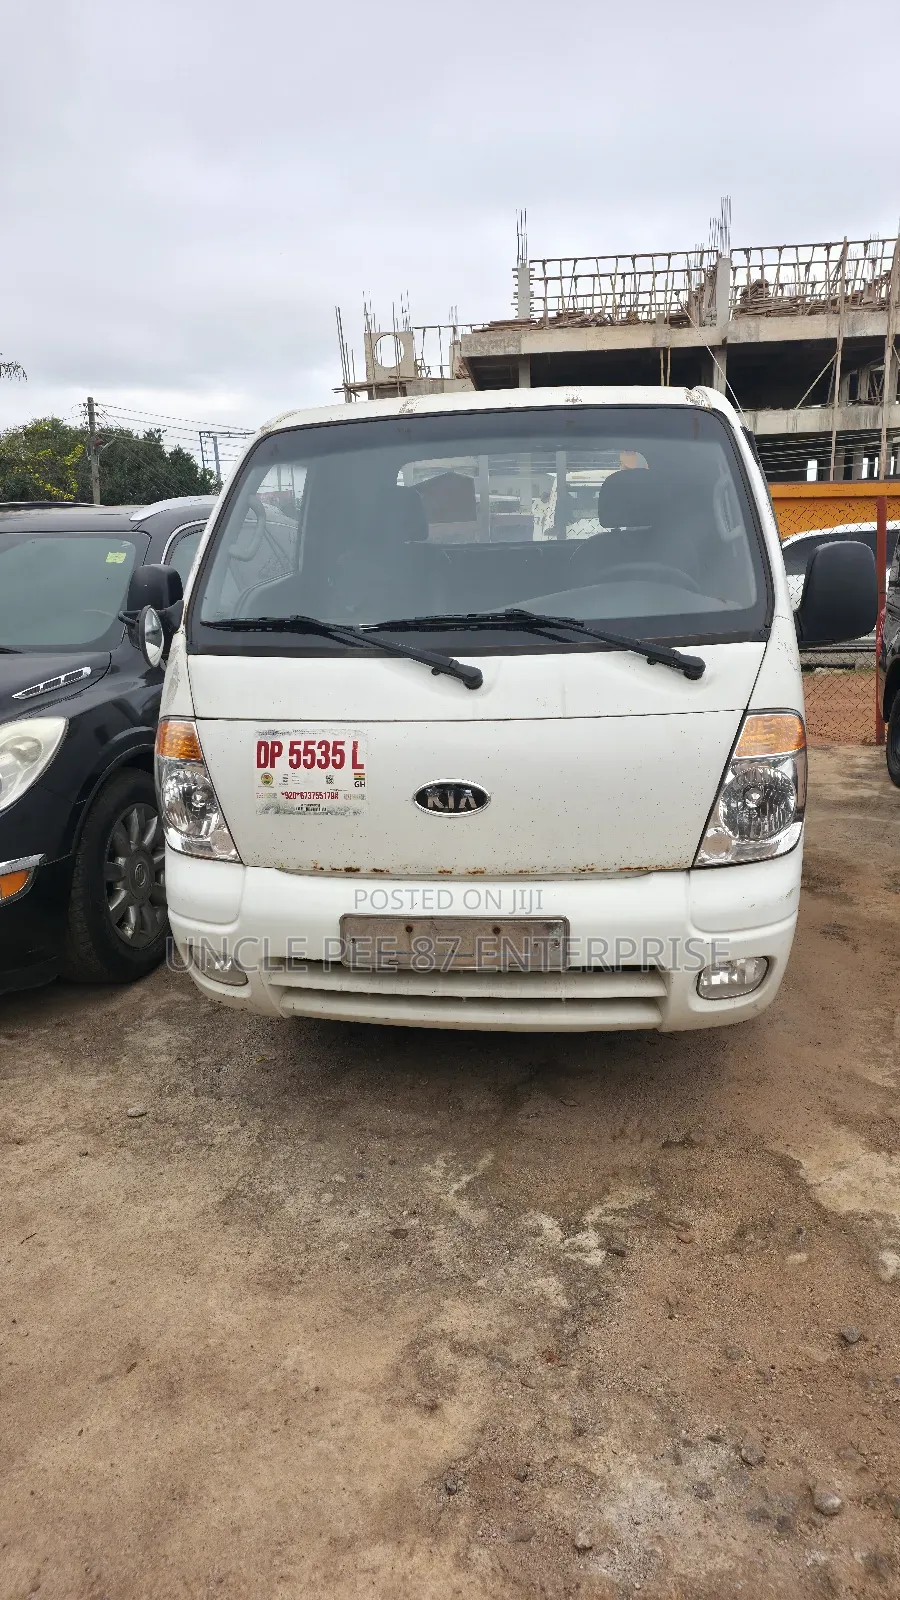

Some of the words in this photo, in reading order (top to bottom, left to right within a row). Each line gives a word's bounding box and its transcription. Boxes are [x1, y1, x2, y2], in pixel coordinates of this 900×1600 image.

[256, 740, 283, 768] DP
[288, 739, 345, 769] 5535
[351, 740, 364, 769] L
[354, 780, 366, 788] GH
[426, 788, 477, 809] KIA
